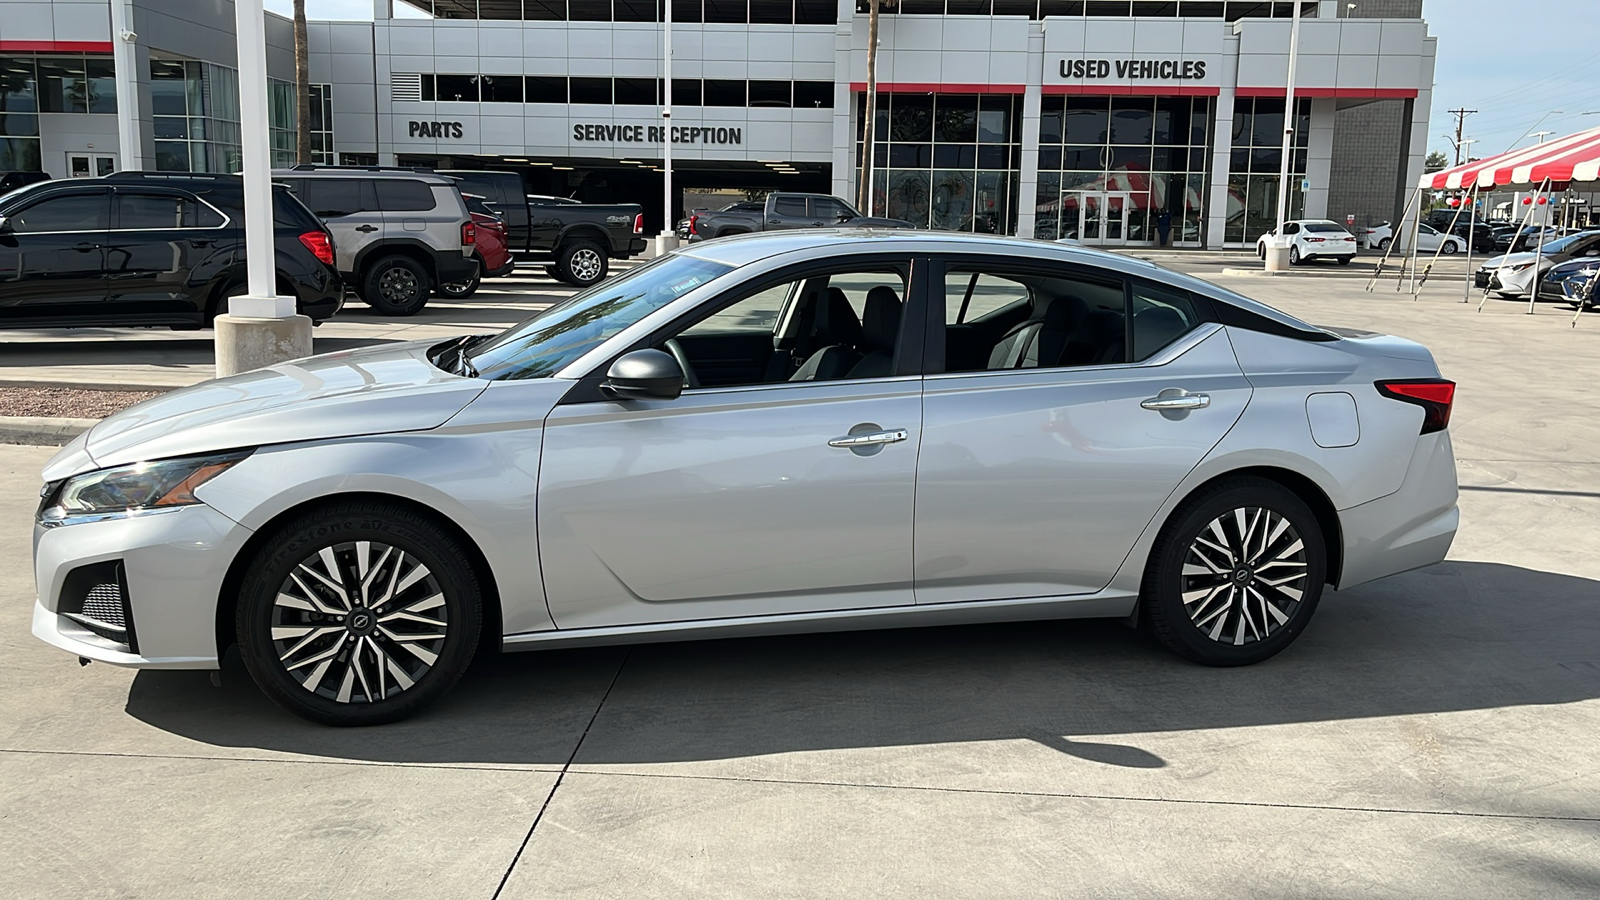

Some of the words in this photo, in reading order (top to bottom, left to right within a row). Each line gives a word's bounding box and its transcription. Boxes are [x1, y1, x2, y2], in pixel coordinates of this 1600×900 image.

[1060, 59, 1110, 79] USED
[1116, 60, 1206, 80] VEHICLES
[408, 120, 463, 139] PARTS
[573, 123, 644, 143] SERVICE
[647, 125, 742, 145] RECEPTION
